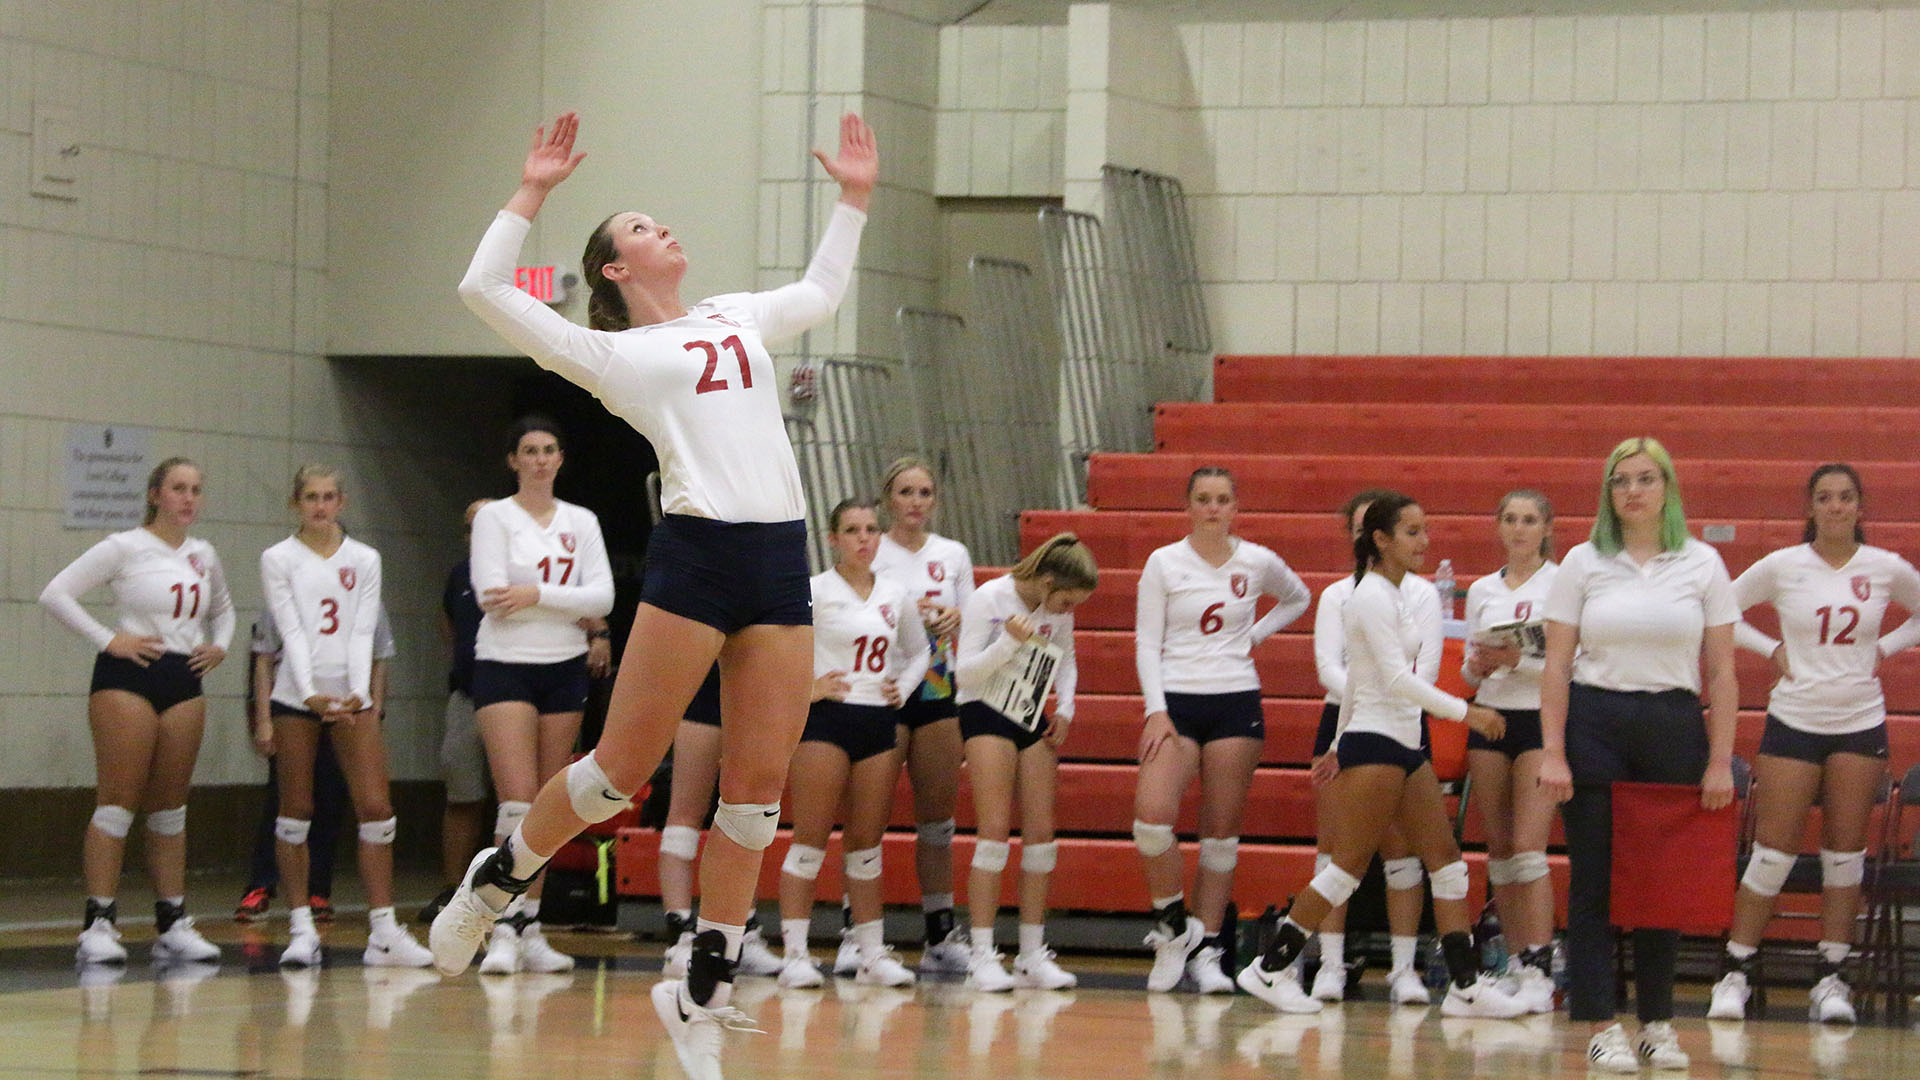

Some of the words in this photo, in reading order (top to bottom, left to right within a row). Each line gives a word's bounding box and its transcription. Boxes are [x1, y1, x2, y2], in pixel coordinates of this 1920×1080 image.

[514, 266, 555, 302] EXIT
[683, 335, 752, 394] 21
[537, 556, 575, 586] 17
[170, 583, 200, 619] 11
[320, 598, 339, 635] 3
[1200, 602, 1225, 636] 6
[1816, 605, 1860, 645] 12
[853, 635, 889, 673] 18
